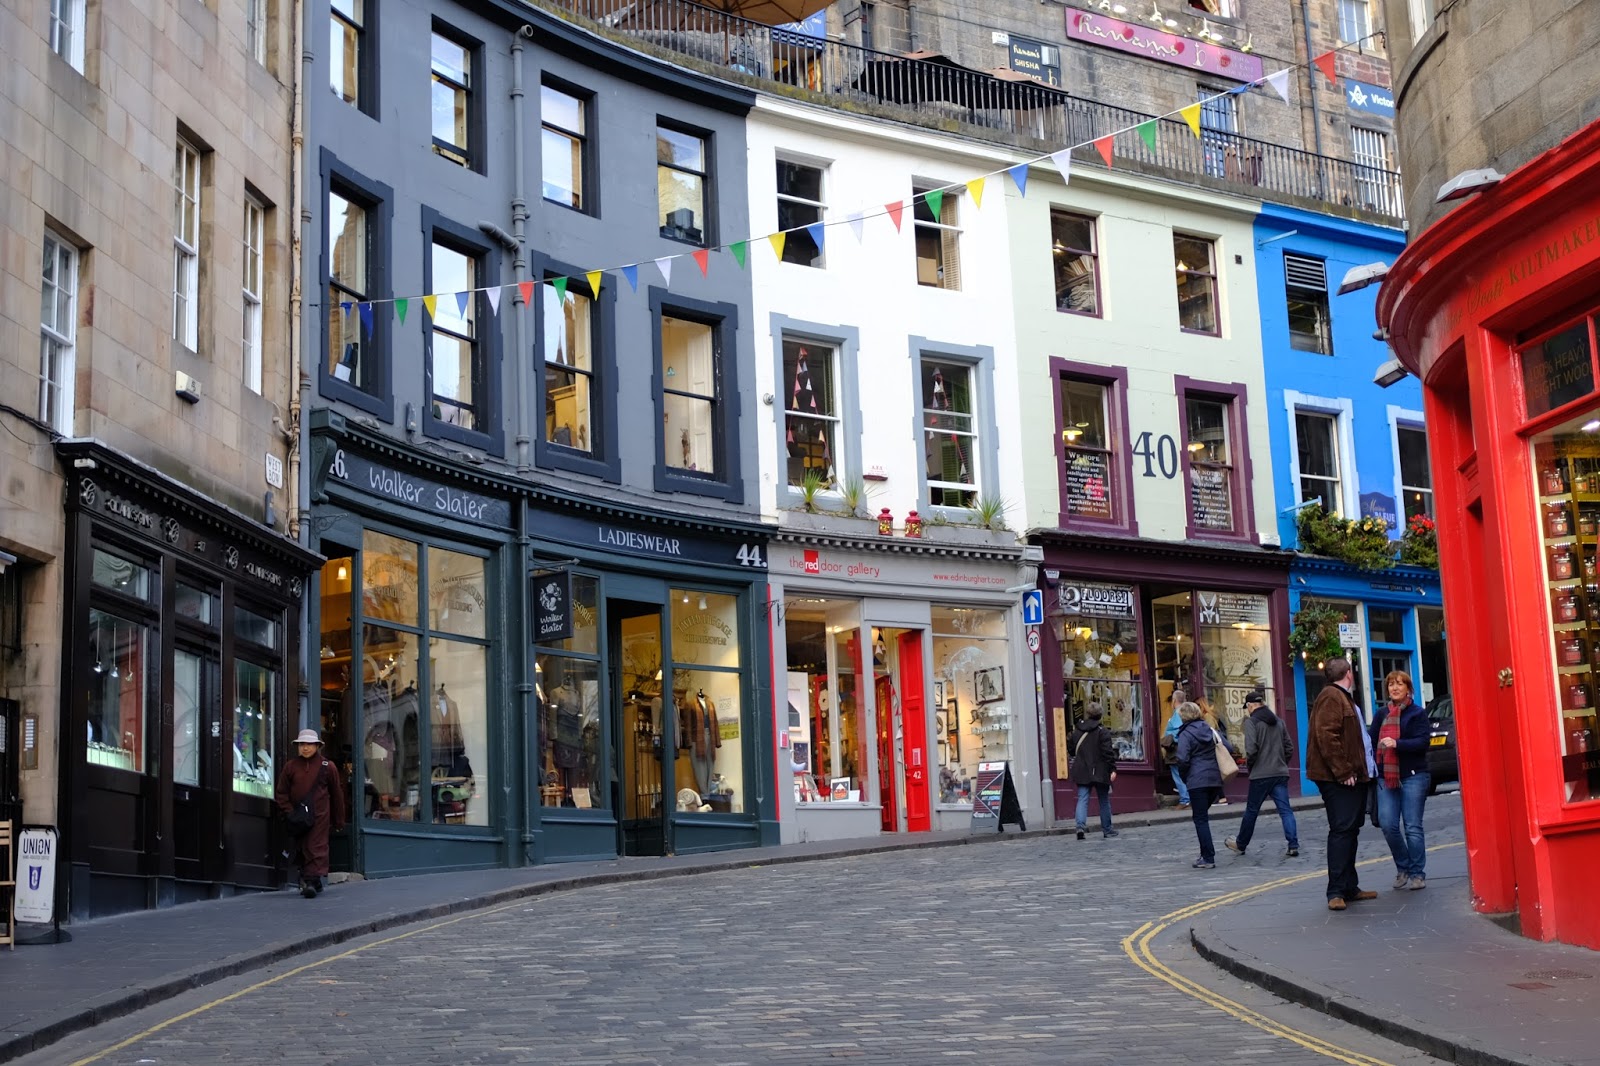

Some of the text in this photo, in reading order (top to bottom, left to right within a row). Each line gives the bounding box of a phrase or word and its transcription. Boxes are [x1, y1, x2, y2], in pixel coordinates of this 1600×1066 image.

[1014, 58, 1040, 70] SHISHA
[1554, 344, 1585, 370] HEAVY
[268, 455, 280, 472] WEST
[1132, 432, 1178, 480] 40
[268, 469, 280, 482] BOW
[370, 466, 487, 520] Walker Slater
[598, 527, 768, 568] LADIESWEAR 44.
[789, 556, 880, 578] the red door gallery
[1081, 588, 1127, 604] FLOORS!
[540, 613, 564, 624] Walker
[540, 622, 564, 634] Slater
[1030, 636, 1038, 647] 20
[912, 770, 922, 780] 42
[23, 838, 50, 854] UNION
